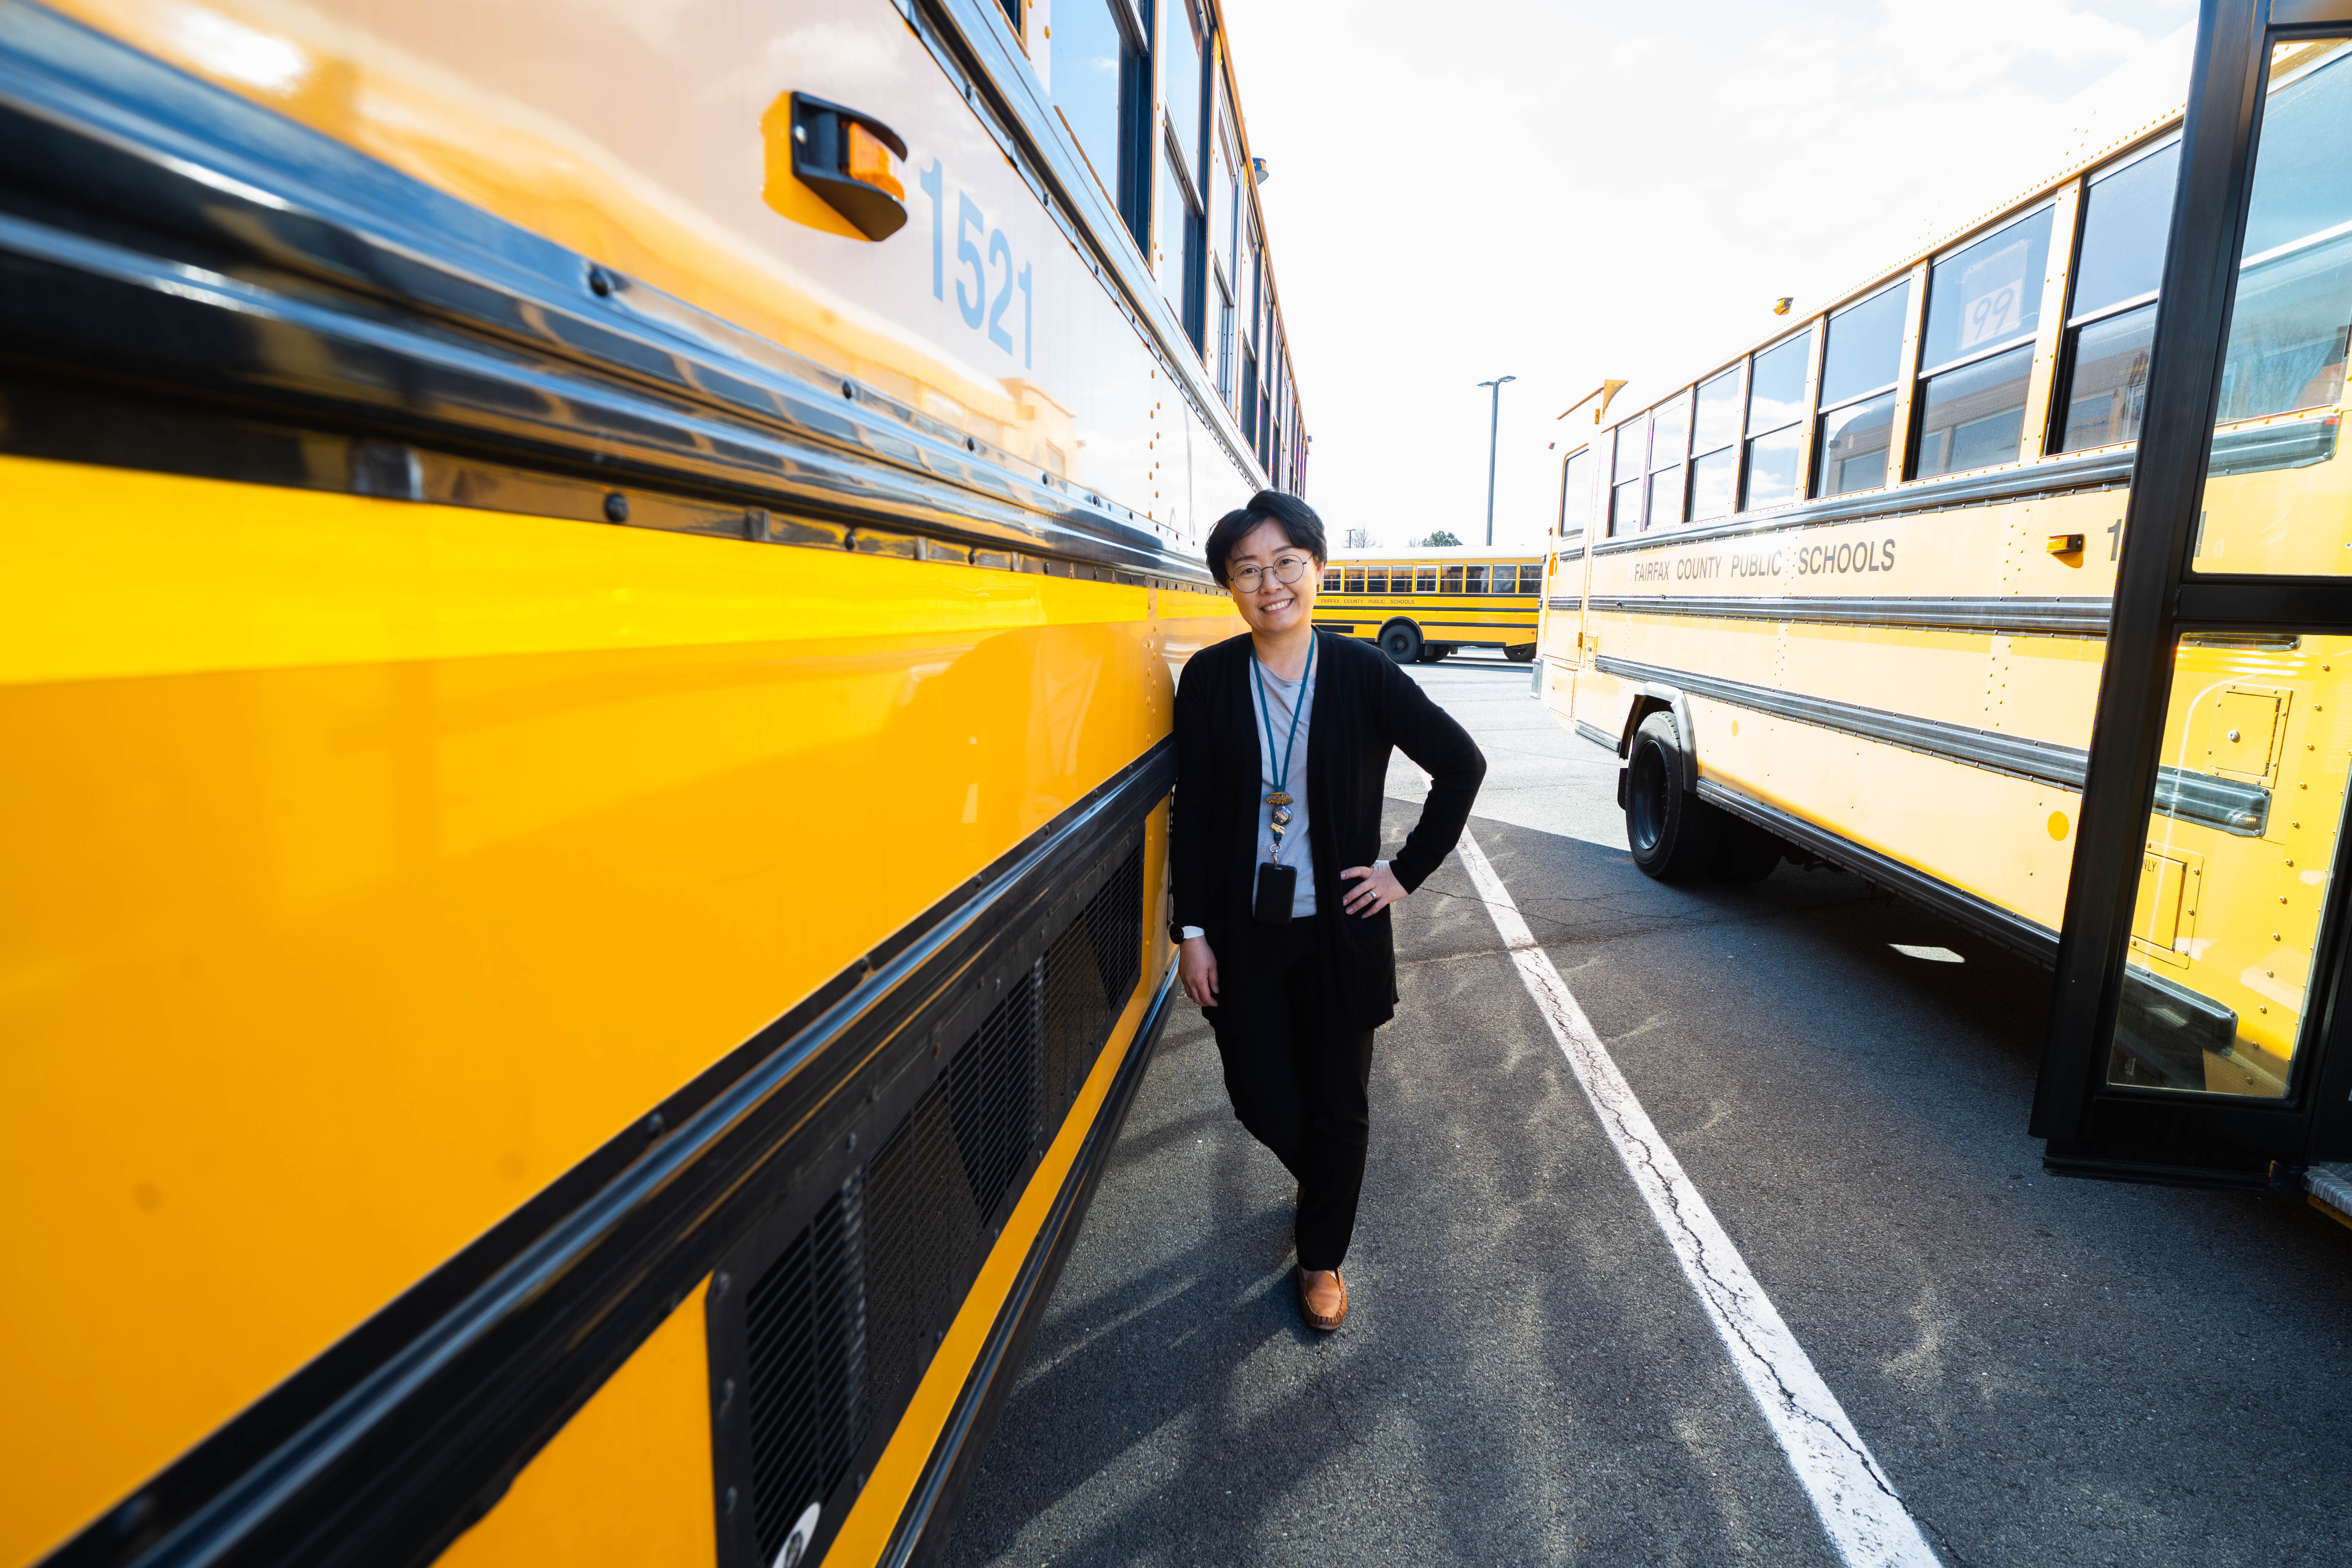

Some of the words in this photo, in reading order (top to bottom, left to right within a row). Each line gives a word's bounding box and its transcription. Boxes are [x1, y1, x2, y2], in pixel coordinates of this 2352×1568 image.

[920, 156, 1032, 371] 1521
[1973, 288, 2015, 340] 99
[1634, 560, 1670, 582] FAIRFAX
[1677, 556, 1722, 580] COUNTY
[1731, 550, 1783, 577] PUBLIC
[1798, 539, 1895, 575] SCHOOLS
[2143, 858, 2157, 873] NLY
